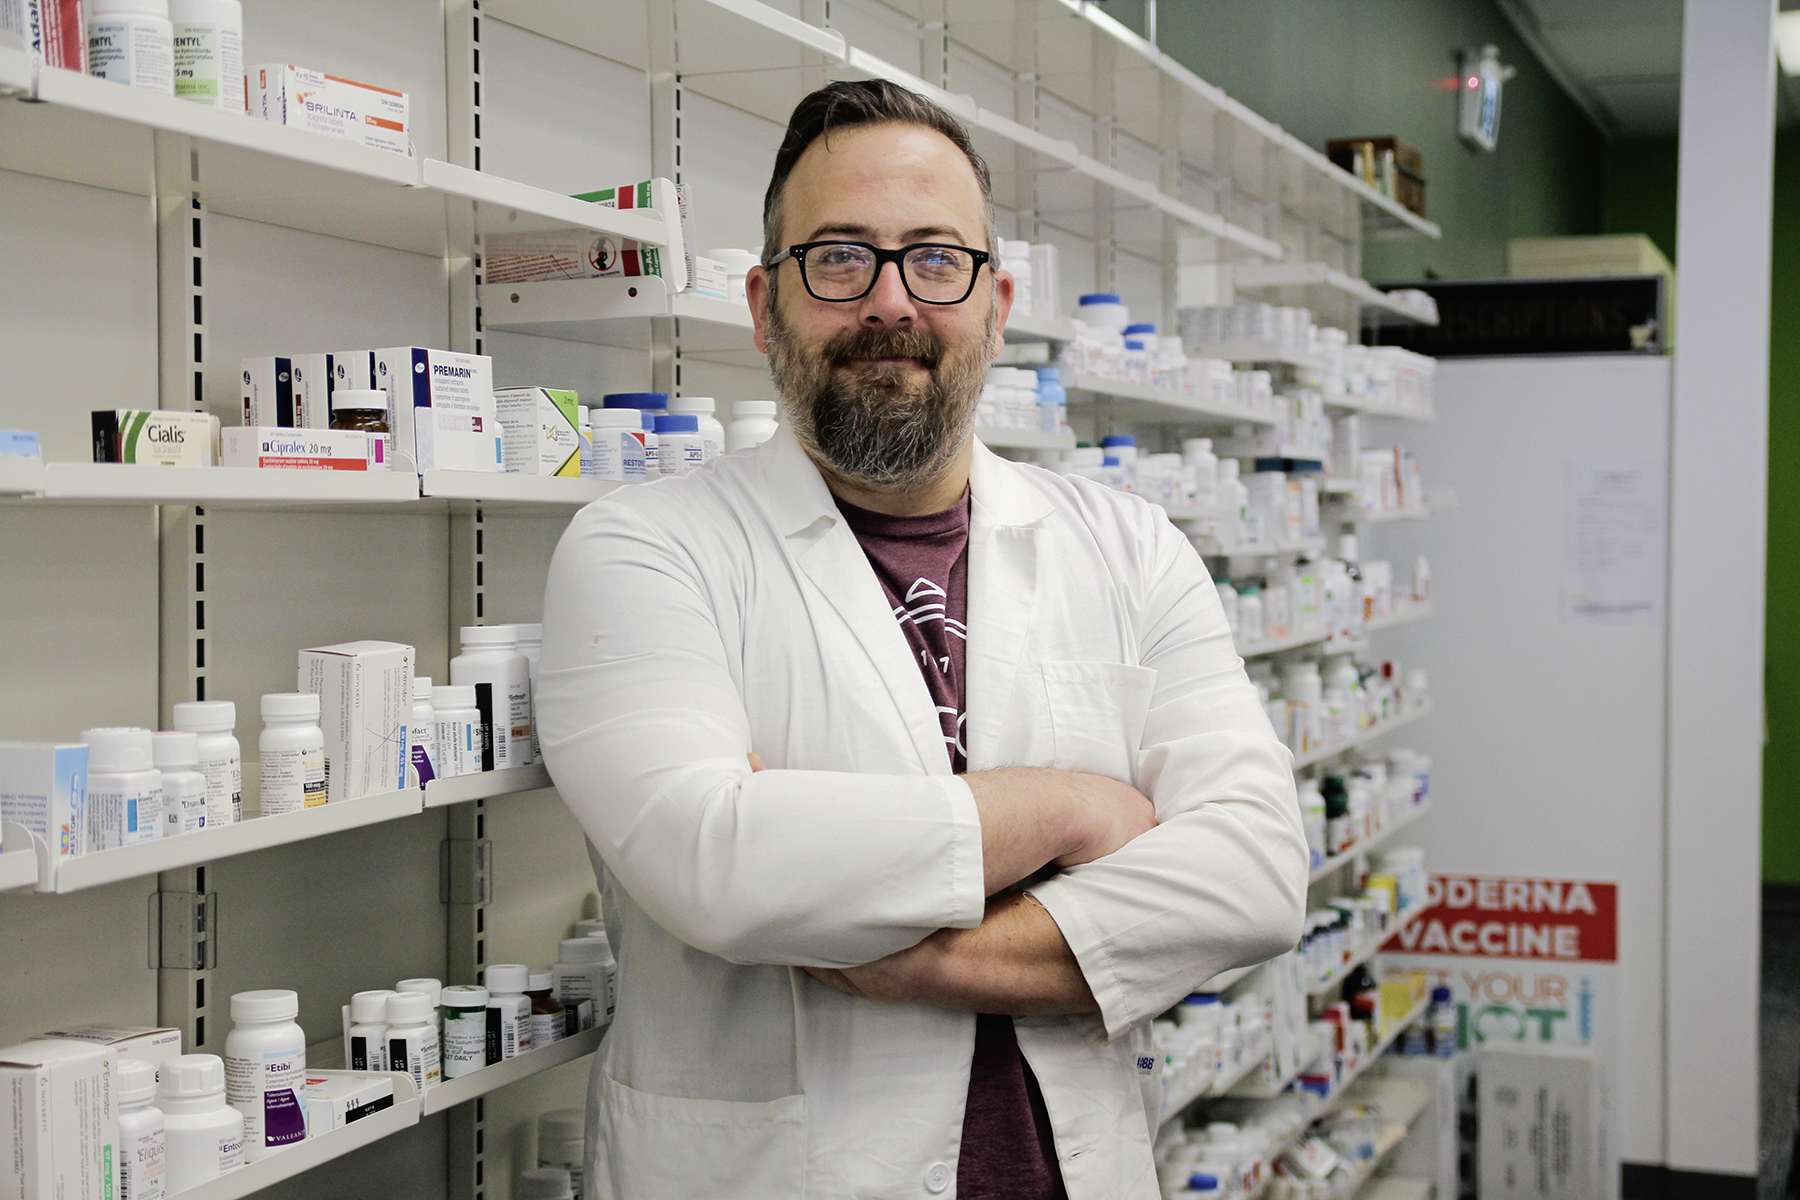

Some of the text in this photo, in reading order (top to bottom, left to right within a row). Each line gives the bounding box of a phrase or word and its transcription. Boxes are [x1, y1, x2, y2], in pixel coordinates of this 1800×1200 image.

[29, 0, 41, 54] Adal
[305, 101, 357, 121] BRILINTA
[433, 365, 471, 378] PREMARIN
[147, 424, 185, 443] Cialis
[270, 440, 332, 457] Cipralex 20 mg
[1401, 917, 1580, 957] VACCINE
[1461, 970, 1568, 1005] YOUR
[270, 1063, 291, 1073] Etibi
